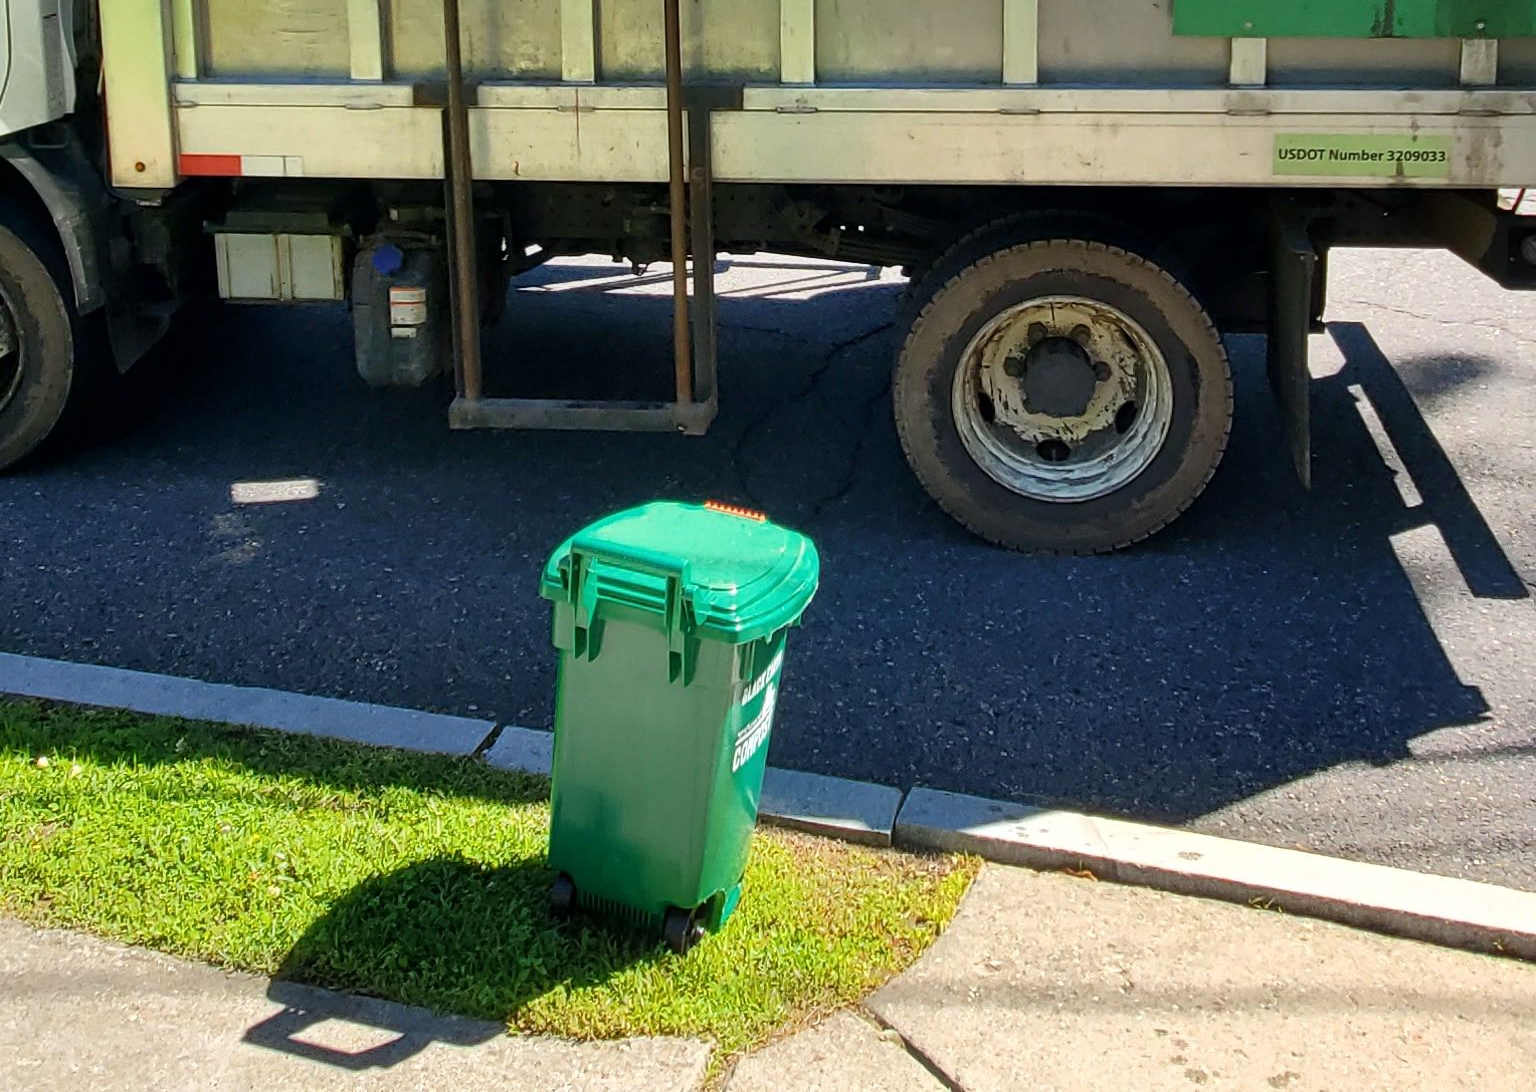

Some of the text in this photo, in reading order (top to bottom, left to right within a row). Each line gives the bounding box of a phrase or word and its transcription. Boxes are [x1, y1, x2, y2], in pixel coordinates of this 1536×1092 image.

[1278, 148, 1447, 163] USDOT Number 3209033
